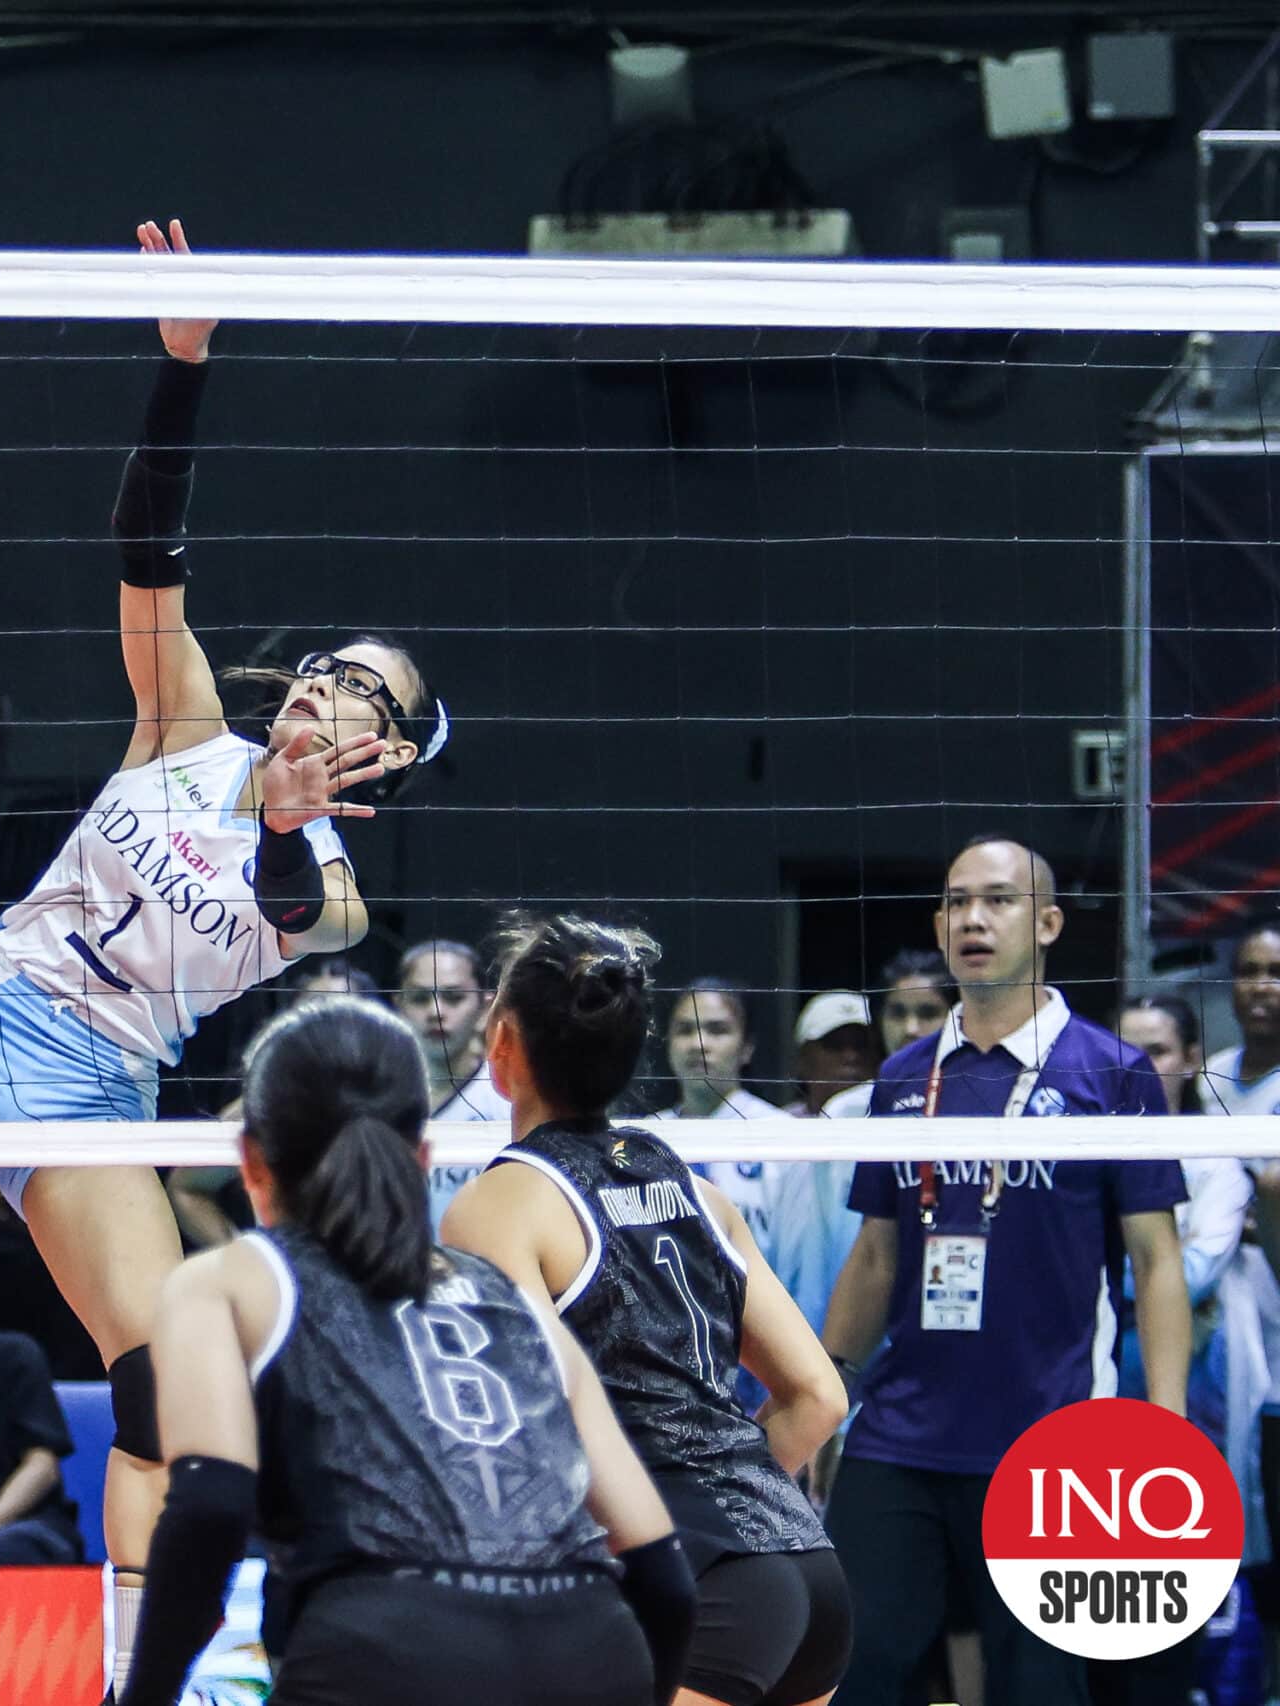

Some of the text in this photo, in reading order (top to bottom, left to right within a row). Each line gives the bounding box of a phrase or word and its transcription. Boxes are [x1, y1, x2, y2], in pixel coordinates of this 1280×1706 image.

[94, 798, 254, 952] ADAMSON
[166, 830, 221, 881] Akari
[395, 1299, 519, 1446] 6
[655, 1236, 720, 1394] 1
